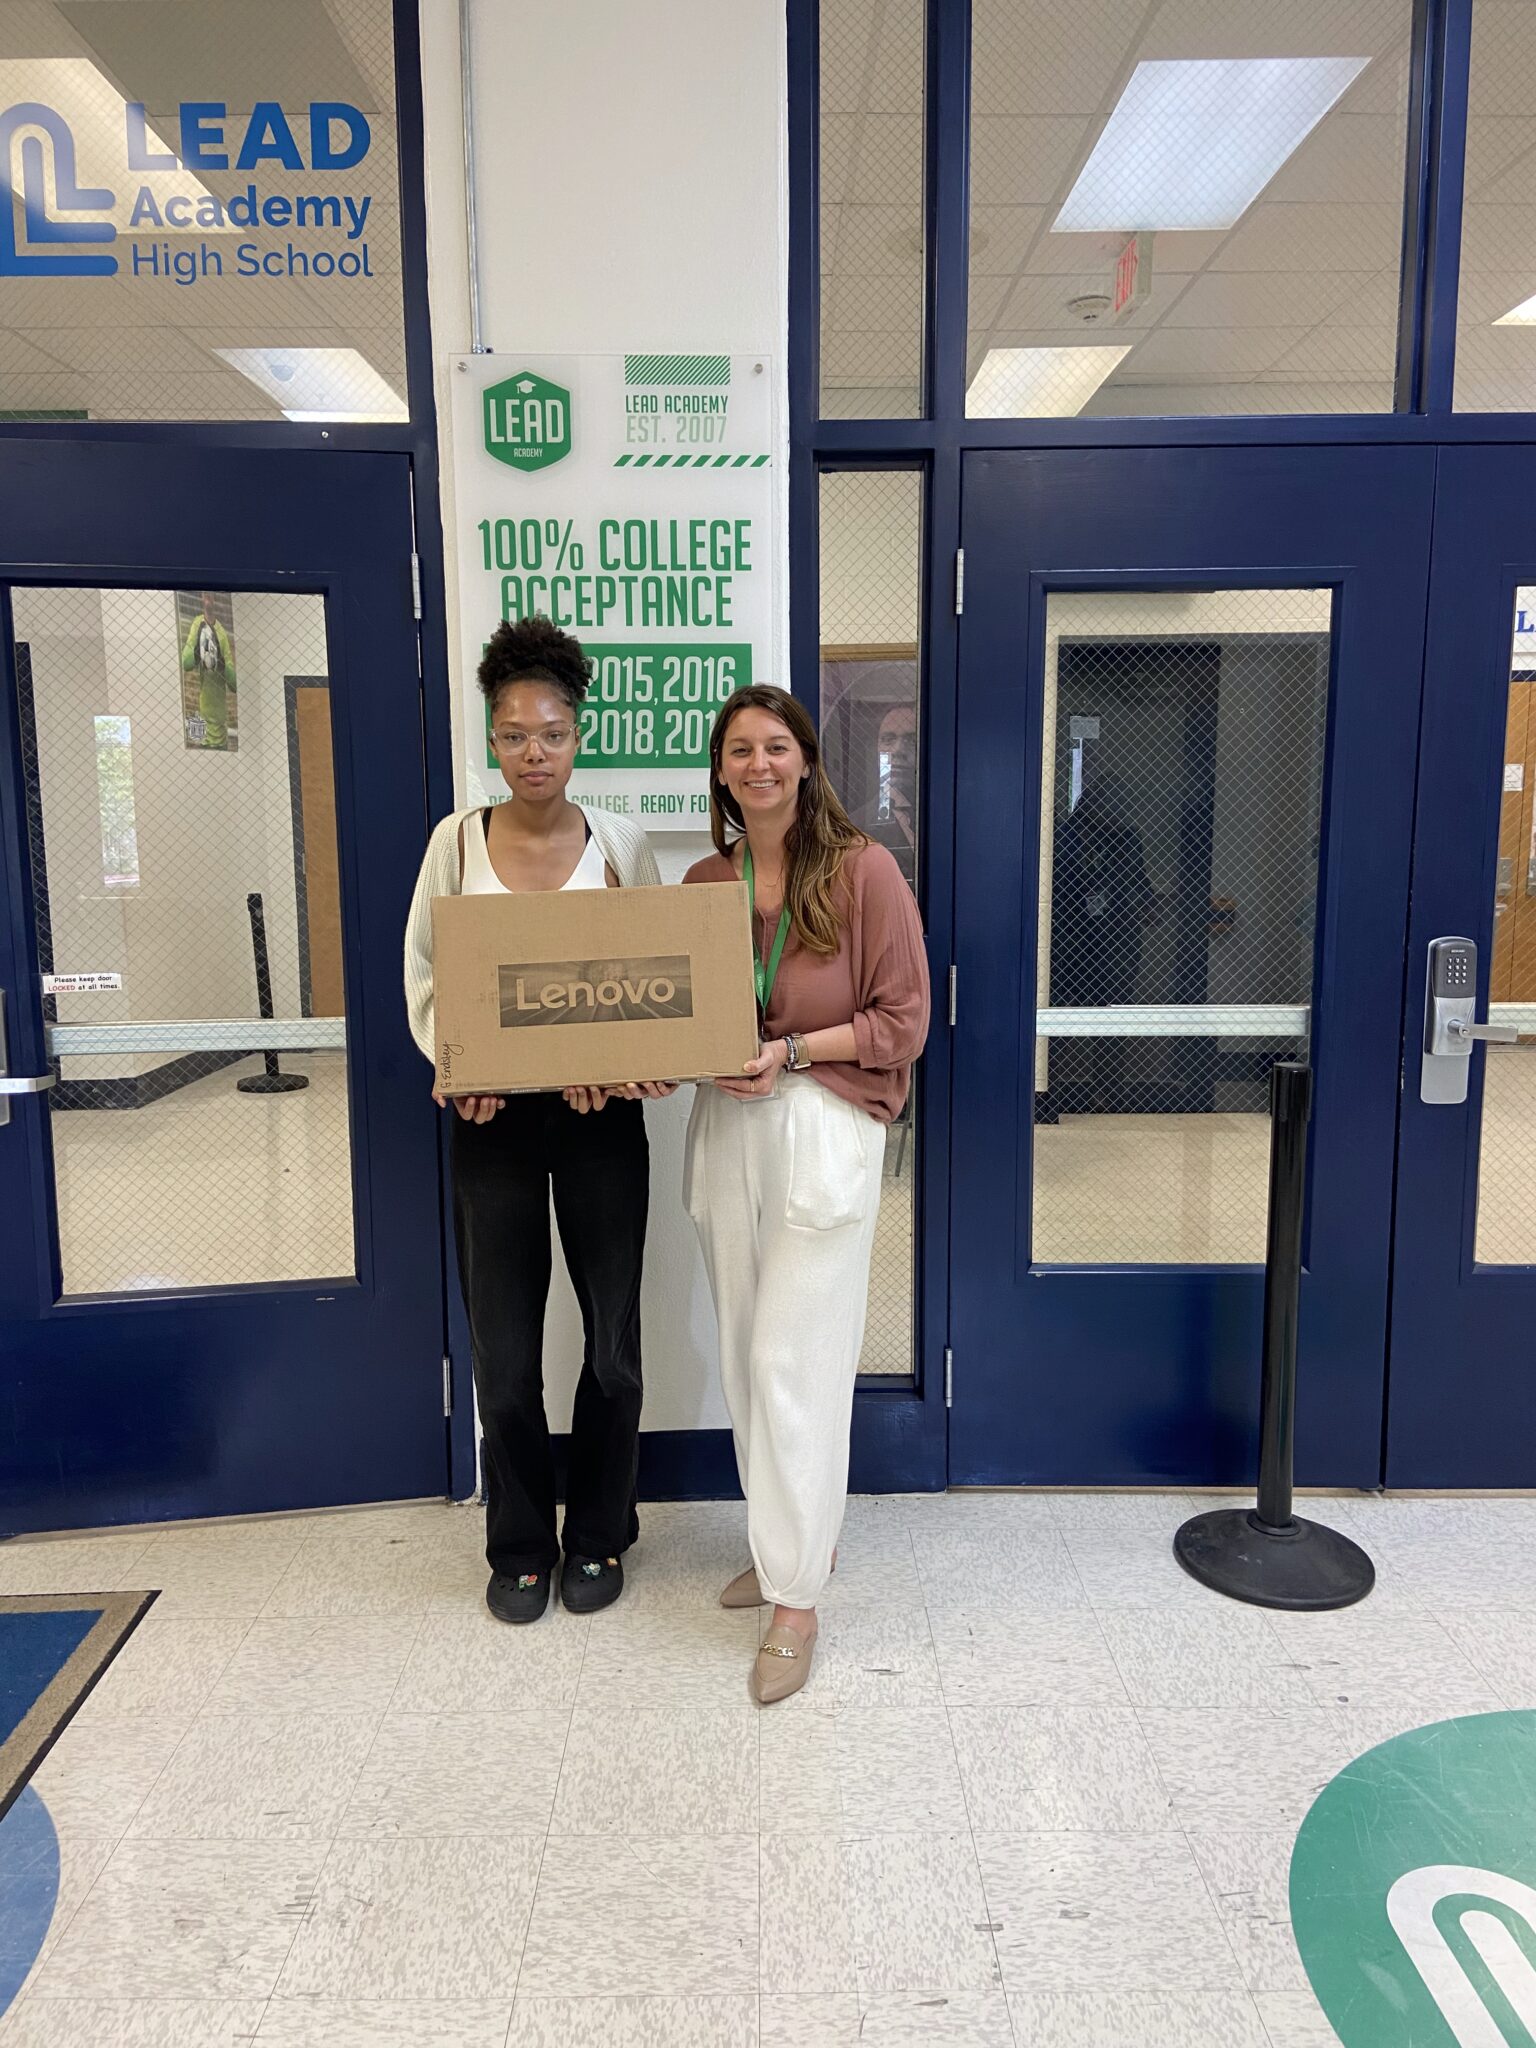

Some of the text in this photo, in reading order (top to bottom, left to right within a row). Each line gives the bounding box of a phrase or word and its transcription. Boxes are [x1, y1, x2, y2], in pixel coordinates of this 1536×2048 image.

[125, 102, 372, 171] LEAD
[129, 184, 372, 240] Academy
[131, 243, 374, 286] High School
[489, 398, 565, 444] LEAD
[625, 394, 729, 414] LEAD ACADEMY
[626, 415, 728, 443] EST. 2007
[513, 447, 543, 458] ACADEMY
[477, 518, 753, 571] 100% COLLEGE
[501, 576, 733, 627] ACCEPTANCE
[640, 794, 685, 814] READY
[690, 794, 711, 814] FO
[515, 977, 676, 1011] Lenovo
